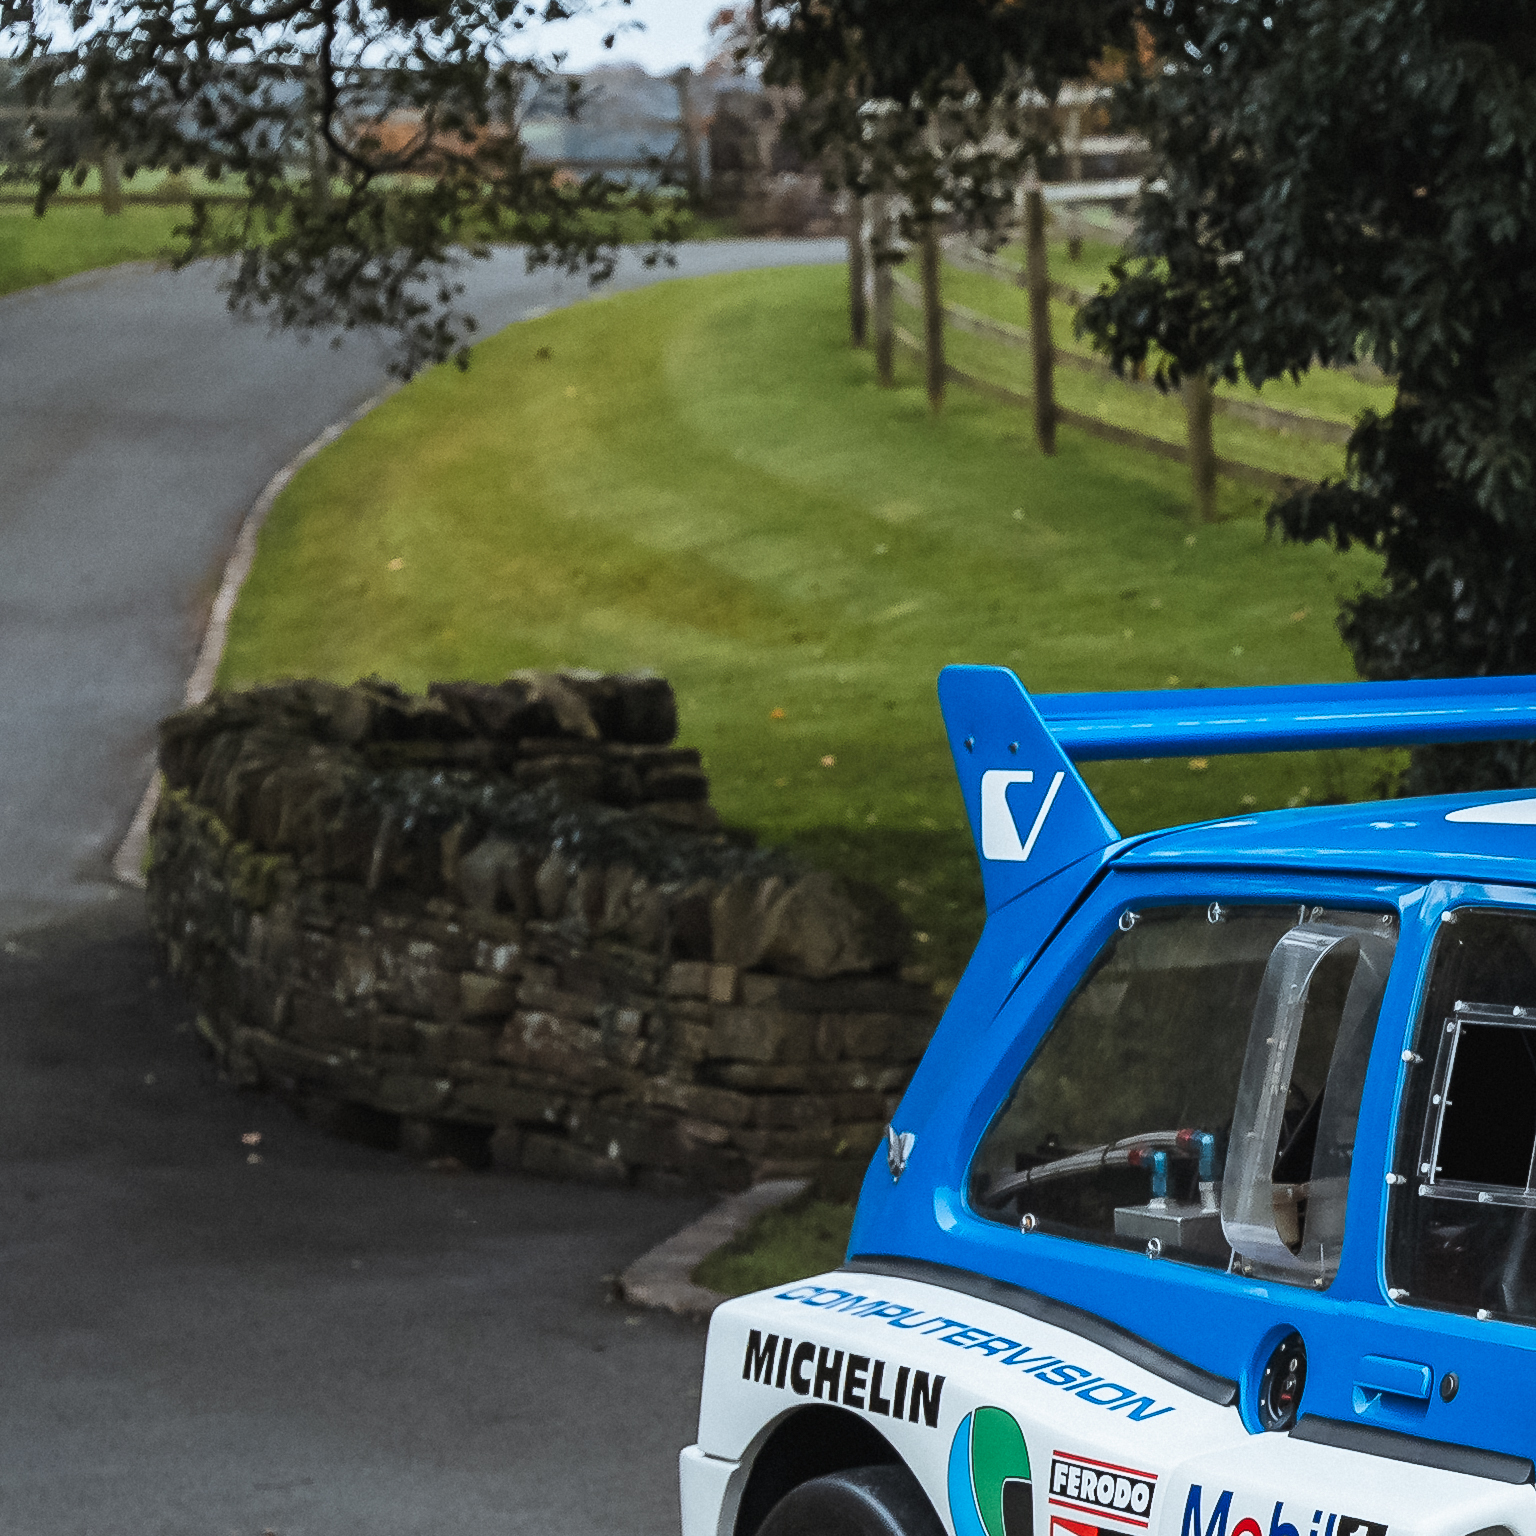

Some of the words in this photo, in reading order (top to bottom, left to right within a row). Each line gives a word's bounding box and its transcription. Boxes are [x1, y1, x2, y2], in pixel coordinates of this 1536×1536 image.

[742, 1328, 946, 1429] MICHELIN
[774, 1285, 1177, 1422] COMPUTERVISION
[1052, 1462, 1150, 1513] FERODO
